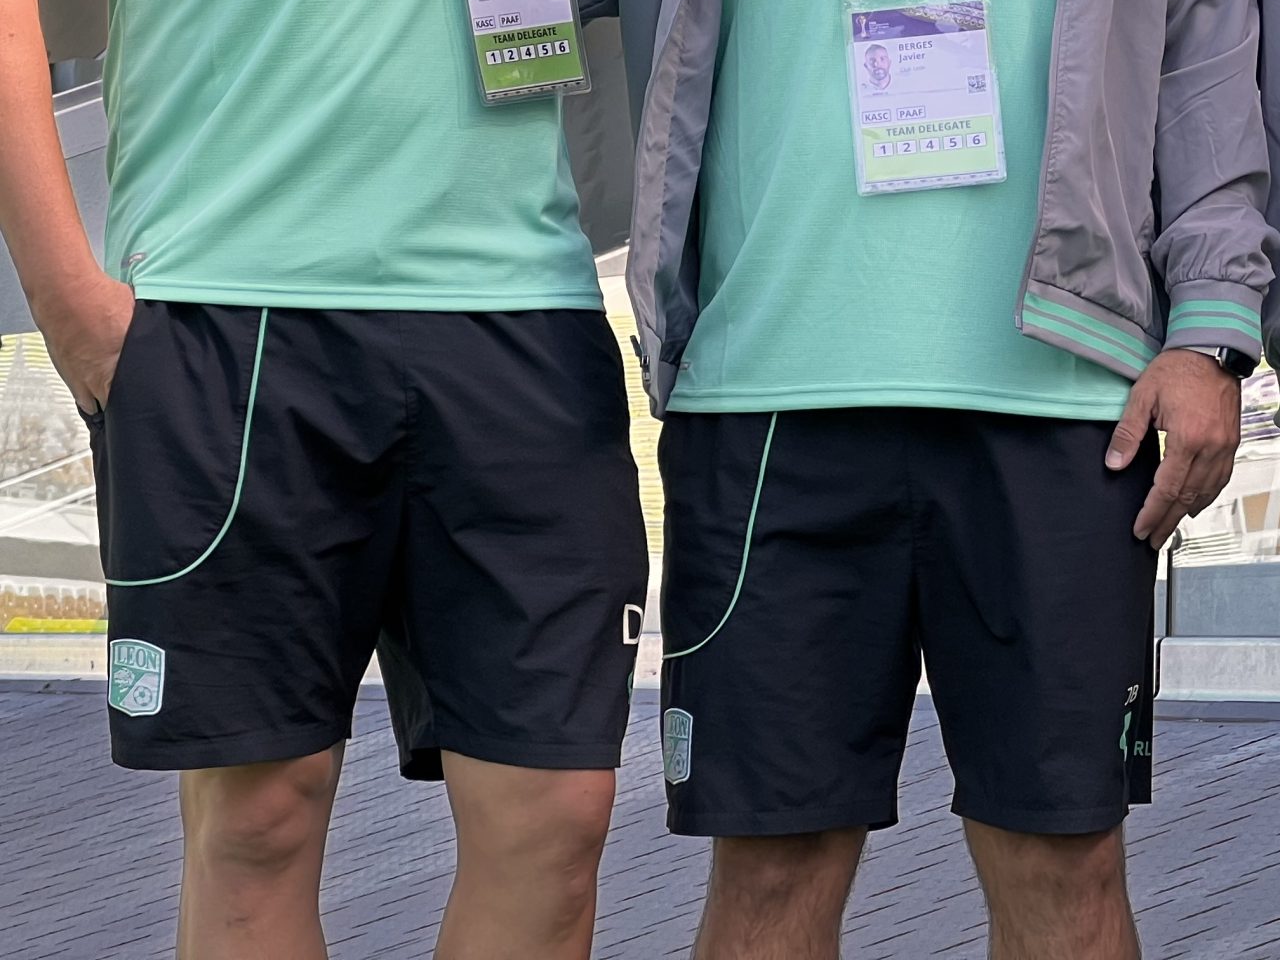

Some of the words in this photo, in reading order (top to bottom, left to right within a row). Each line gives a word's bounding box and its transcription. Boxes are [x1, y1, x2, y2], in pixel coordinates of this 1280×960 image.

[476, 19, 494, 28] KASC
[501, 15, 520, 24] PAAF
[493, 33, 515, 44] TEAM
[517, 27, 557, 41] DELEGATE
[490, 53, 496, 62] 1
[508, 50, 514, 60] 2
[525, 48, 532, 58] 4
[542, 45, 548, 55] 5
[559, 42, 566, 52] 6
[898, 41, 933, 51] BERGES
[899, 52, 926, 63] Javier
[865, 112, 888, 122] KASC
[900, 108, 923, 118] PAAF
[886, 126, 916, 136] TEAM
[918, 120, 971, 134] DELEGATE
[880, 145, 886, 154] 1
[903, 142, 912, 152] 2
[926, 140, 934, 150] 4
[949, 138, 957, 148] 5
[972, 135, 980, 144] 6
[623, 604, 643, 644] D
[118, 646, 157, 670] LEON
